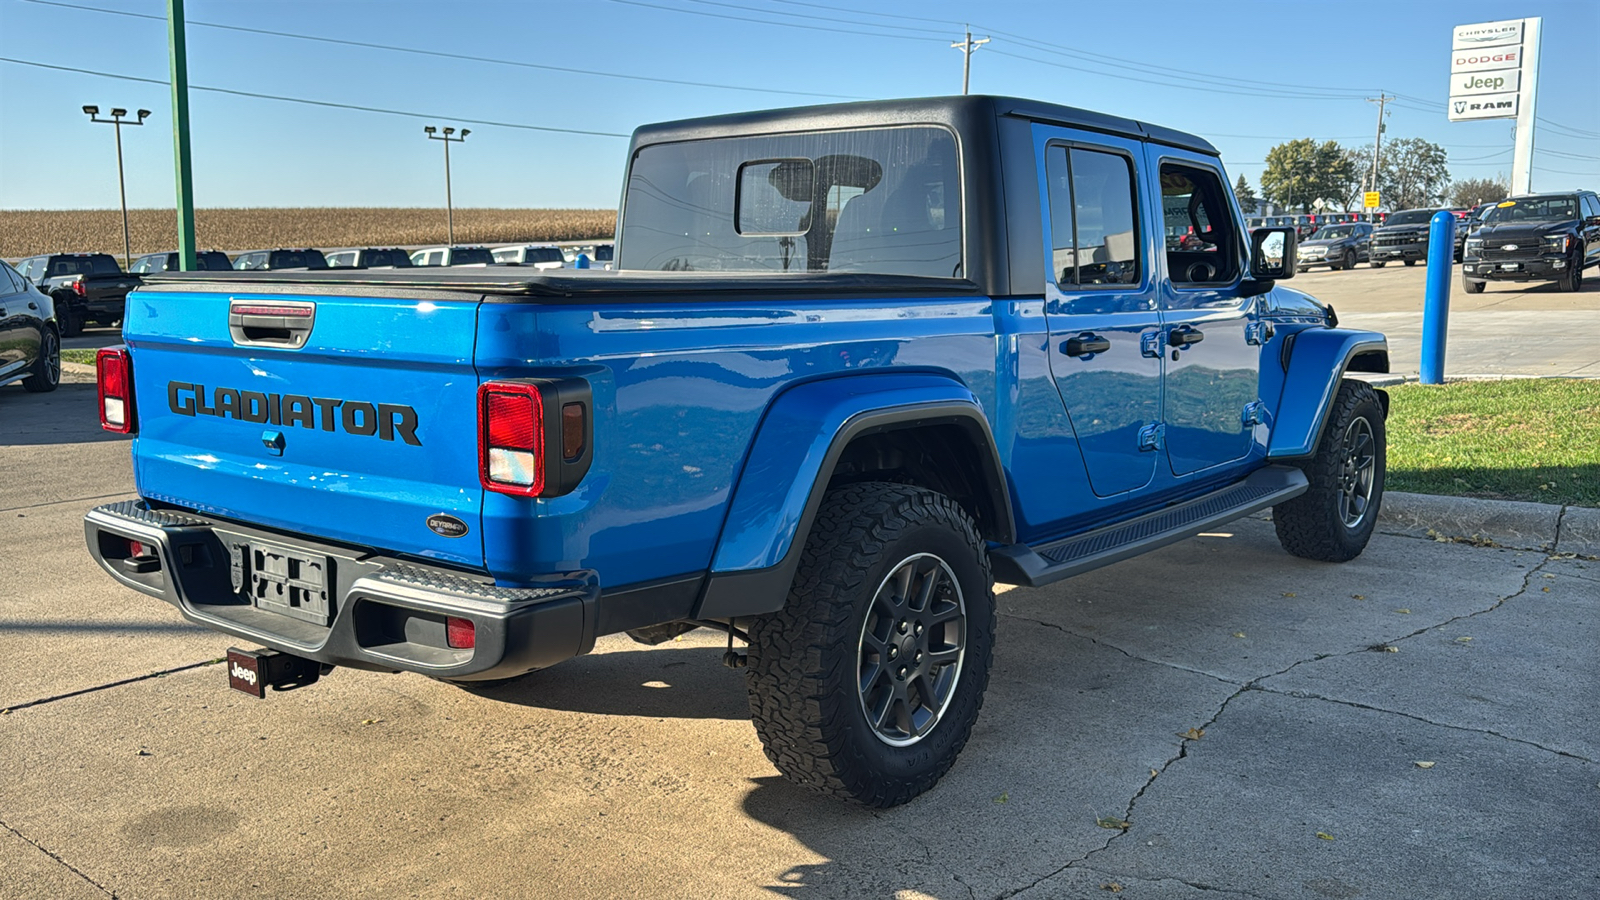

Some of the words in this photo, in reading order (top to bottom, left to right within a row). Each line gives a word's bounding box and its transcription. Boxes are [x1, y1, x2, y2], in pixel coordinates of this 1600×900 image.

[1458, 26, 1516, 37] CHRYSLER
[1456, 53, 1516, 65] DODGE
[1464, 76, 1504, 90] Jeep
[1470, 101, 1513, 110] RAM
[167, 380, 423, 446] GLADIATOR
[231, 661, 257, 685] Jeep
